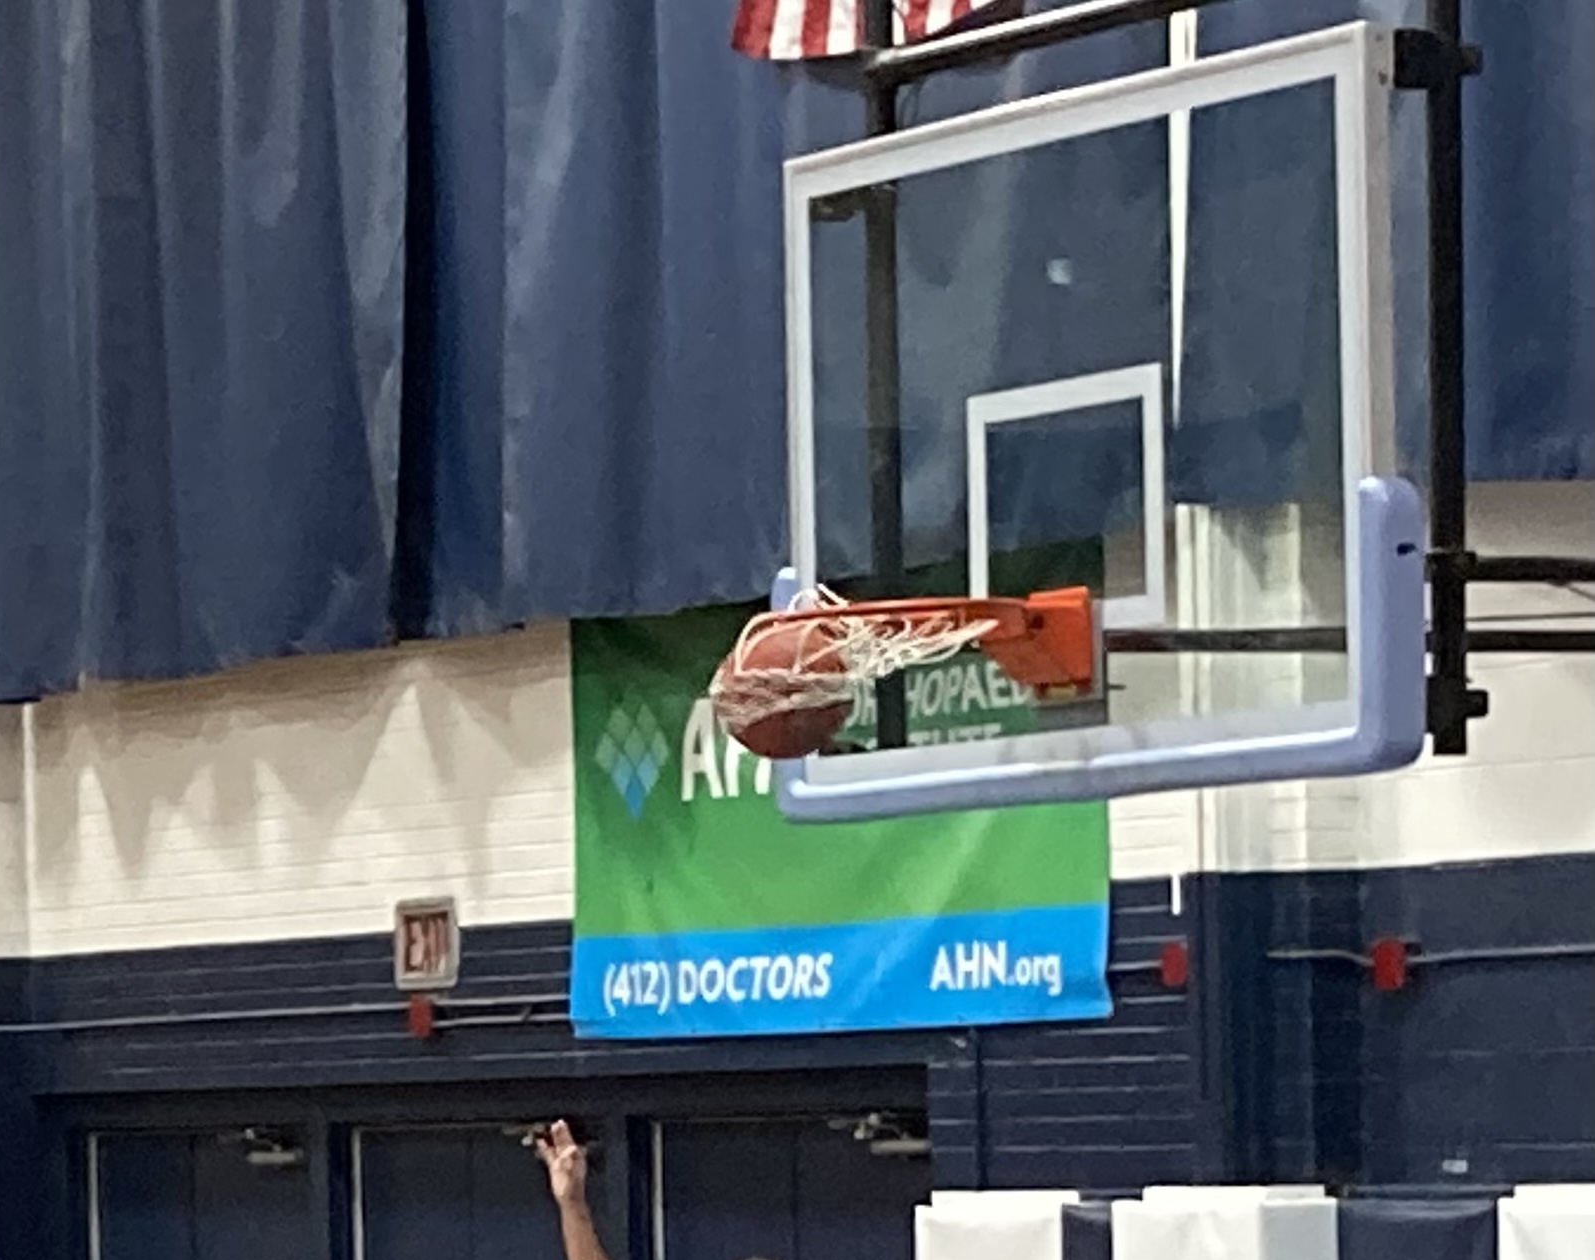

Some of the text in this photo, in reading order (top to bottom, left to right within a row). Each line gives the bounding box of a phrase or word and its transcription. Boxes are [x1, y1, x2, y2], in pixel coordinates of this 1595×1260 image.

[682, 697, 773, 802] AH
[604, 940, 1062, 1016] (412) DOCTORS AHN.org
